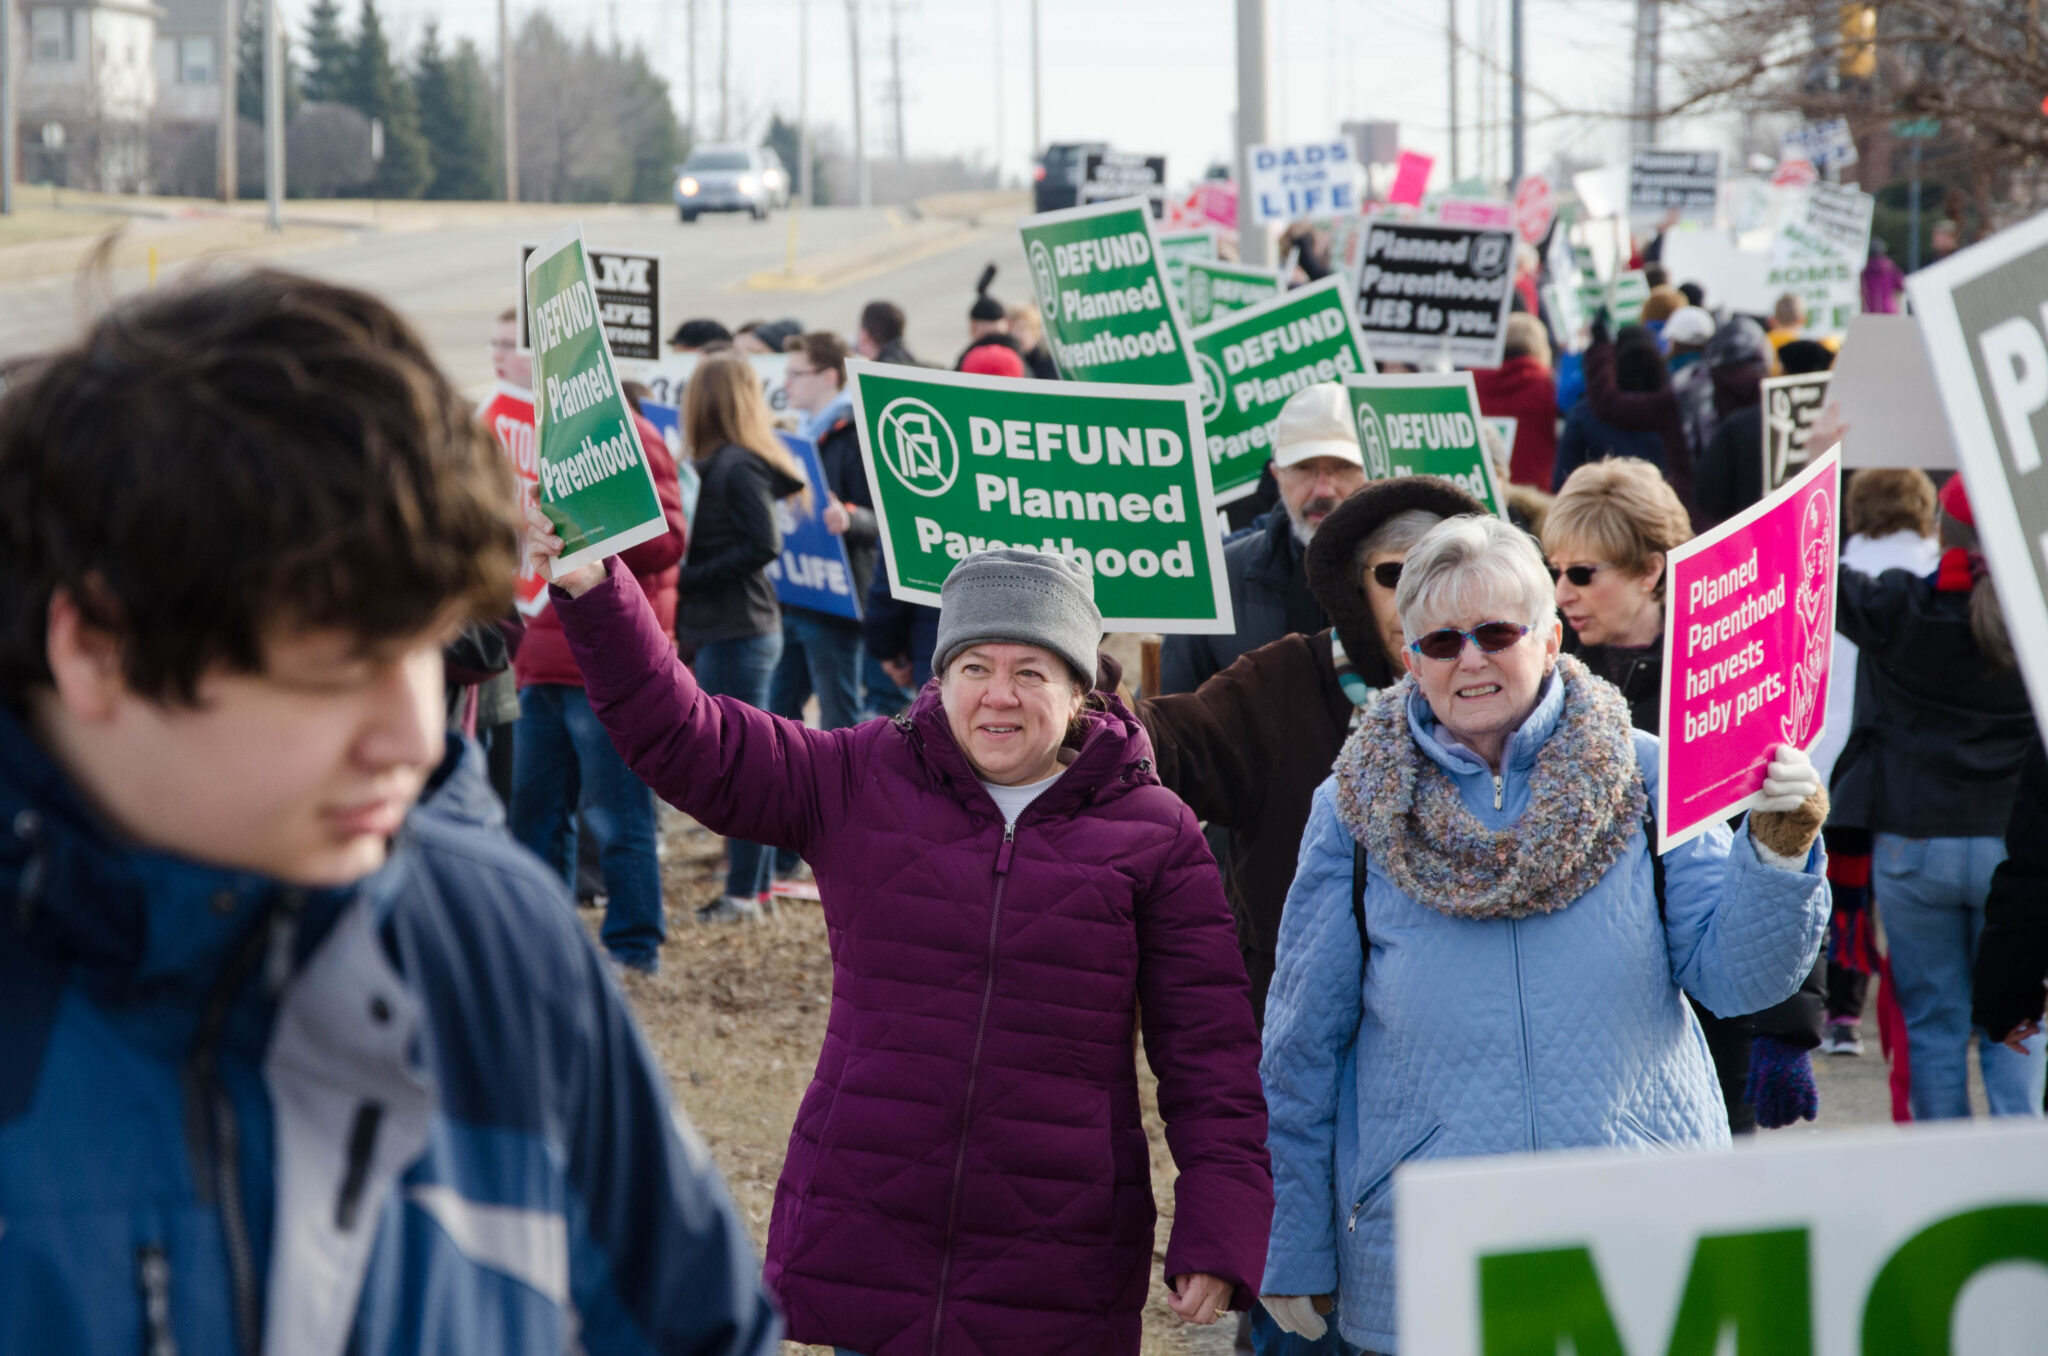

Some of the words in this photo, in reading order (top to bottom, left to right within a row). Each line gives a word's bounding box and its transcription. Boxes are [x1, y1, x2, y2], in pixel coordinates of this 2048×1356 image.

[1257, 143, 1348, 170] DADS
[1261, 184, 1353, 217] LIFE
[1053, 231, 1151, 278] DEFUND
[1368, 229, 1470, 264] Planned
[1062, 277, 1162, 323] Planned
[1361, 264, 1505, 301] Parenthood
[536, 280, 594, 355] DEFUND
[1221, 306, 1346, 376] DEFUND
[1358, 296, 1412, 328] LIES
[1417, 303, 1443, 330] to
[1448, 308, 1498, 336] you.
[1055, 320, 1177, 368] renthood
[546, 350, 614, 424] Planned
[1233, 344, 1357, 413] Planned
[968, 415, 1184, 468] DEFUND
[1384, 412, 1476, 450] DEFUND
[540, 419, 638, 503] Parenthood
[975, 472, 1187, 524] Planned
[782, 549, 850, 596] LIFE
[1688, 546, 1758, 616] Planned
[1687, 572, 1786, 659] Parenthood
[1685, 639, 1764, 701] harvests
[1683, 698, 1733, 744] baby
[1735, 672, 1786, 728] parts.
